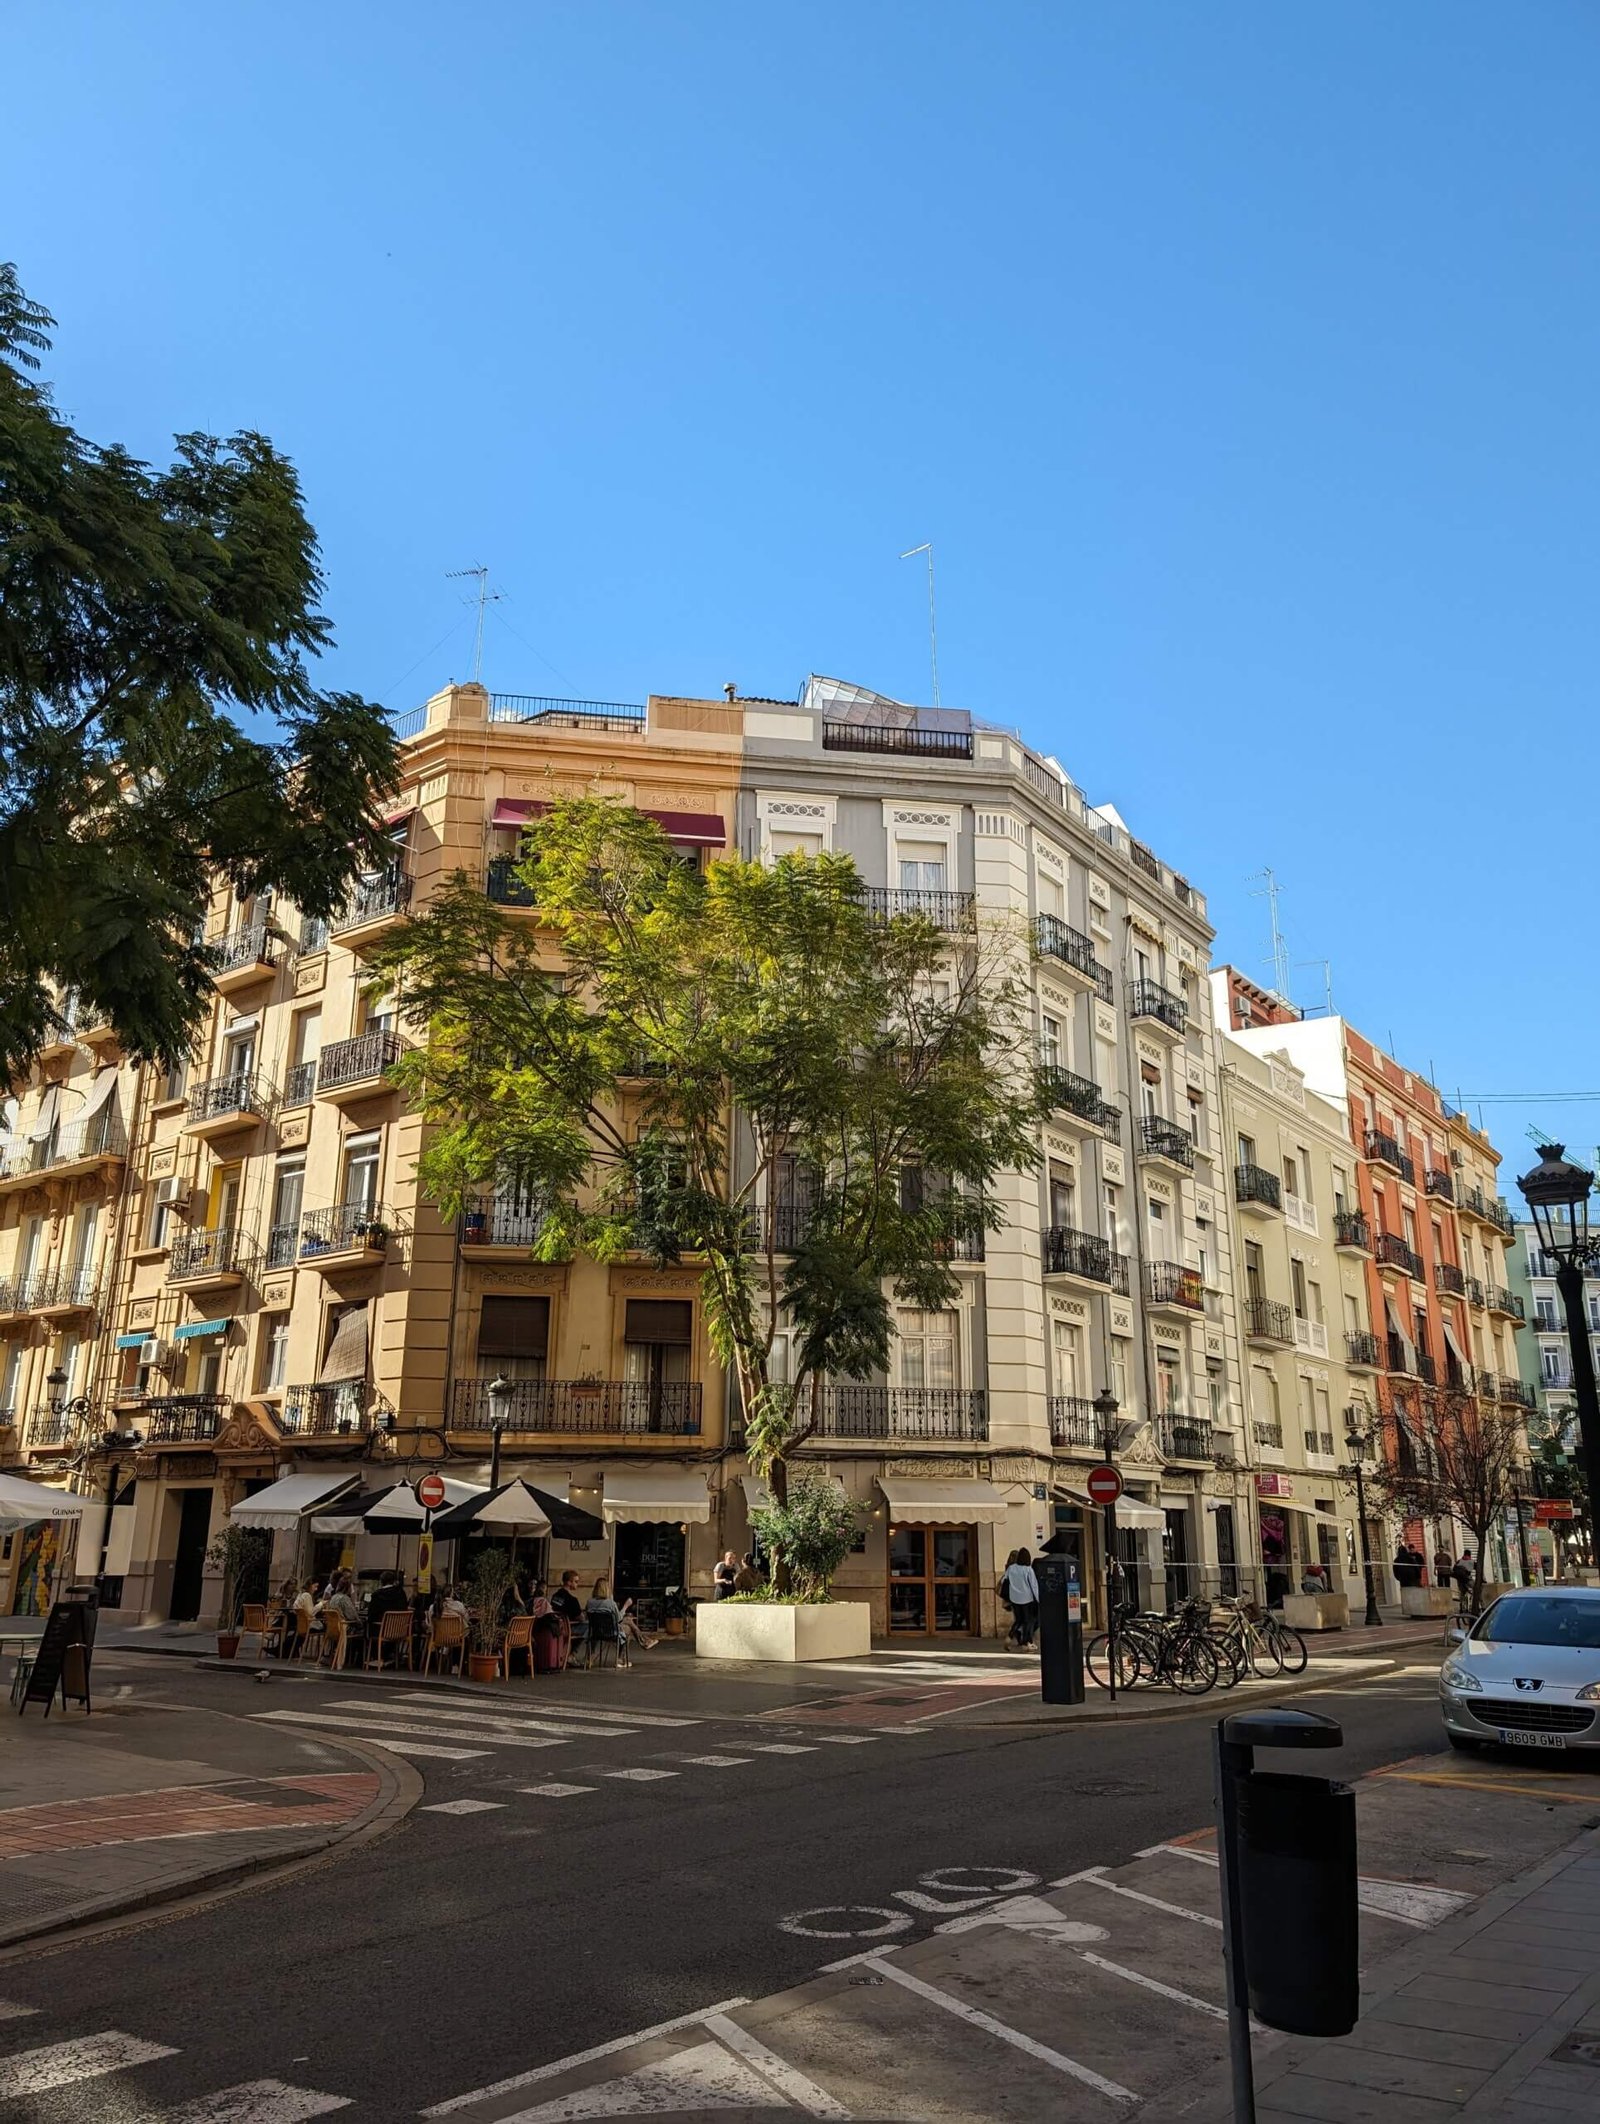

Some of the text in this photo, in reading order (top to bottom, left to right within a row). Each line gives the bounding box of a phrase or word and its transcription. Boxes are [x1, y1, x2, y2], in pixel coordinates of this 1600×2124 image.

[1070, 1565, 1076, 1579] P
[1507, 1732, 1563, 1747] 9609 GMB
